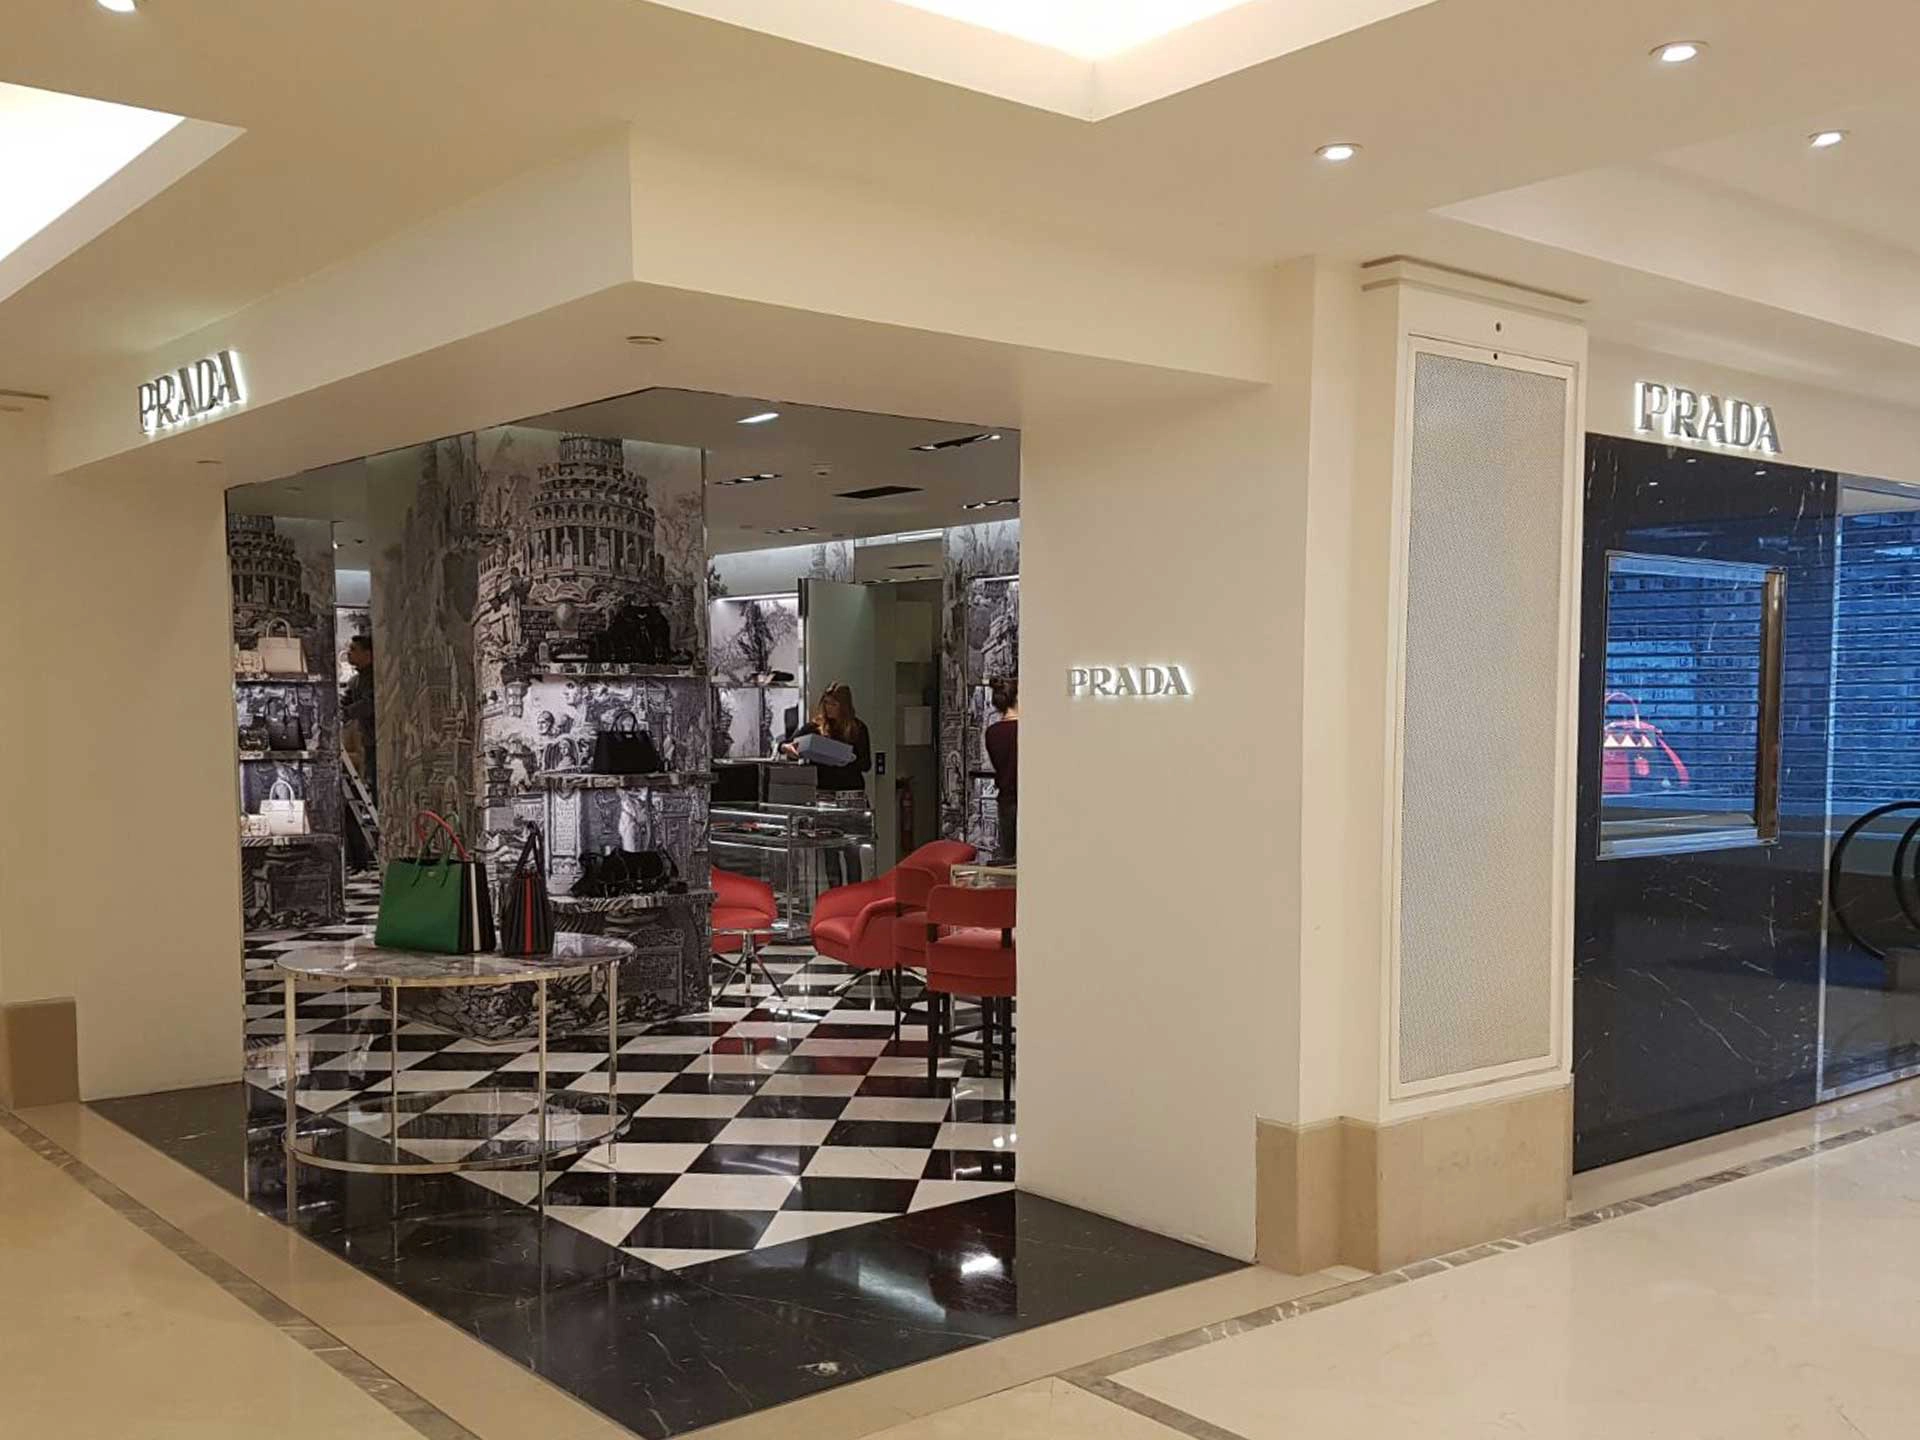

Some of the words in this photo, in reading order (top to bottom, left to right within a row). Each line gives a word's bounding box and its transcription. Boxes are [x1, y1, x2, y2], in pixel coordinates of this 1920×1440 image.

[137, 349, 243, 433] PRADA
[1637, 380, 1782, 454] PRADA
[1065, 665, 1190, 696] PRADA
